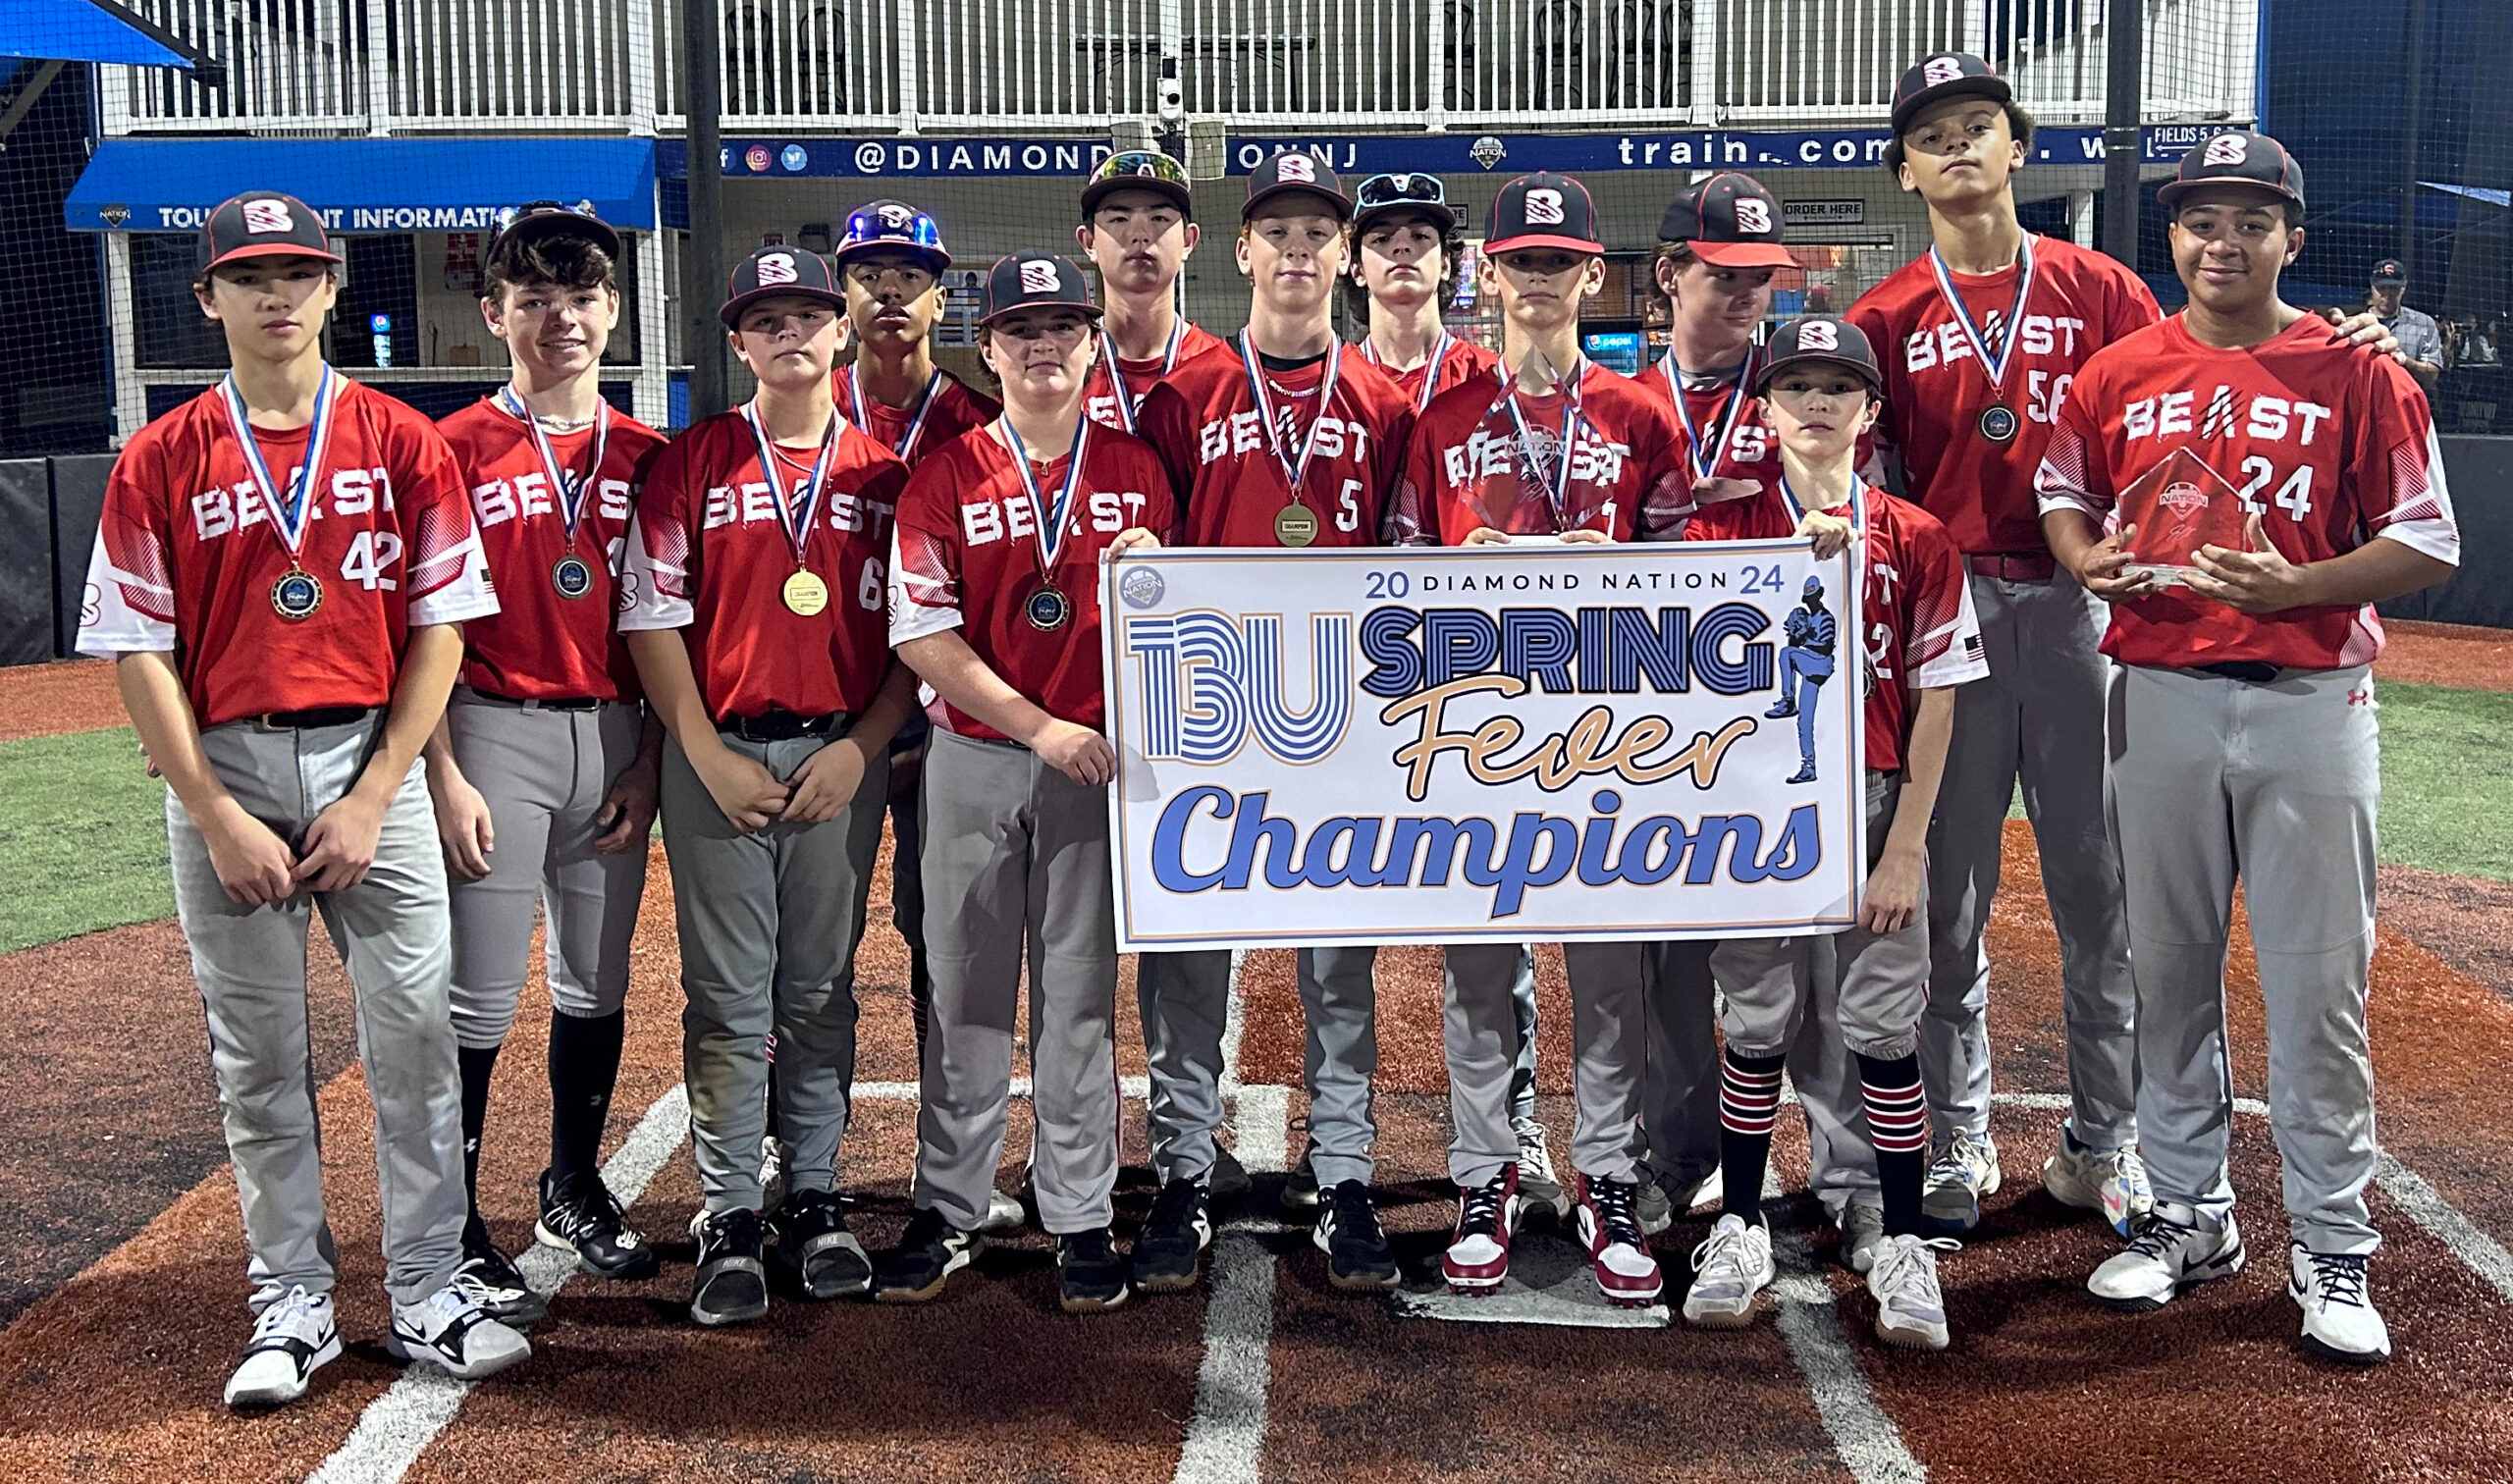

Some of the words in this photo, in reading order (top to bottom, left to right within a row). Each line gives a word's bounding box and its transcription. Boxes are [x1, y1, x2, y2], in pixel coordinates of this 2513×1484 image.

[1470, 147, 1507, 158] NATION
[2155, 127, 2197, 143] FIELDS
[353, 207, 497, 229] INFORMATI
[1785, 204, 1825, 215] ORDER
[1829, 203, 1862, 214] HERE
[1906, 309, 2085, 373] BEAST
[1200, 404, 1370, 466] BEAST
[2122, 384, 2332, 447] BEAST
[1335, 479, 1363, 533] 5
[2160, 494, 2208, 506] NATION
[2238, 454, 2314, 523] 24
[340, 530, 403, 592] 42
[858, 556, 884, 612] 6
[1123, 579, 1163, 599] NATION
[1364, 570, 1410, 599] 20
[1423, 574, 1579, 592] DIAMOND
[1602, 571, 1728, 589] NATION
[1739, 564, 1785, 595] 24
[1359, 602, 1775, 698] SPRING
[1125, 607, 1355, 768] 13U
[1381, 673, 1757, 804] Fever
[1150, 784, 1824, 922] Champions
[816, 1234, 838, 1249] NIKE
